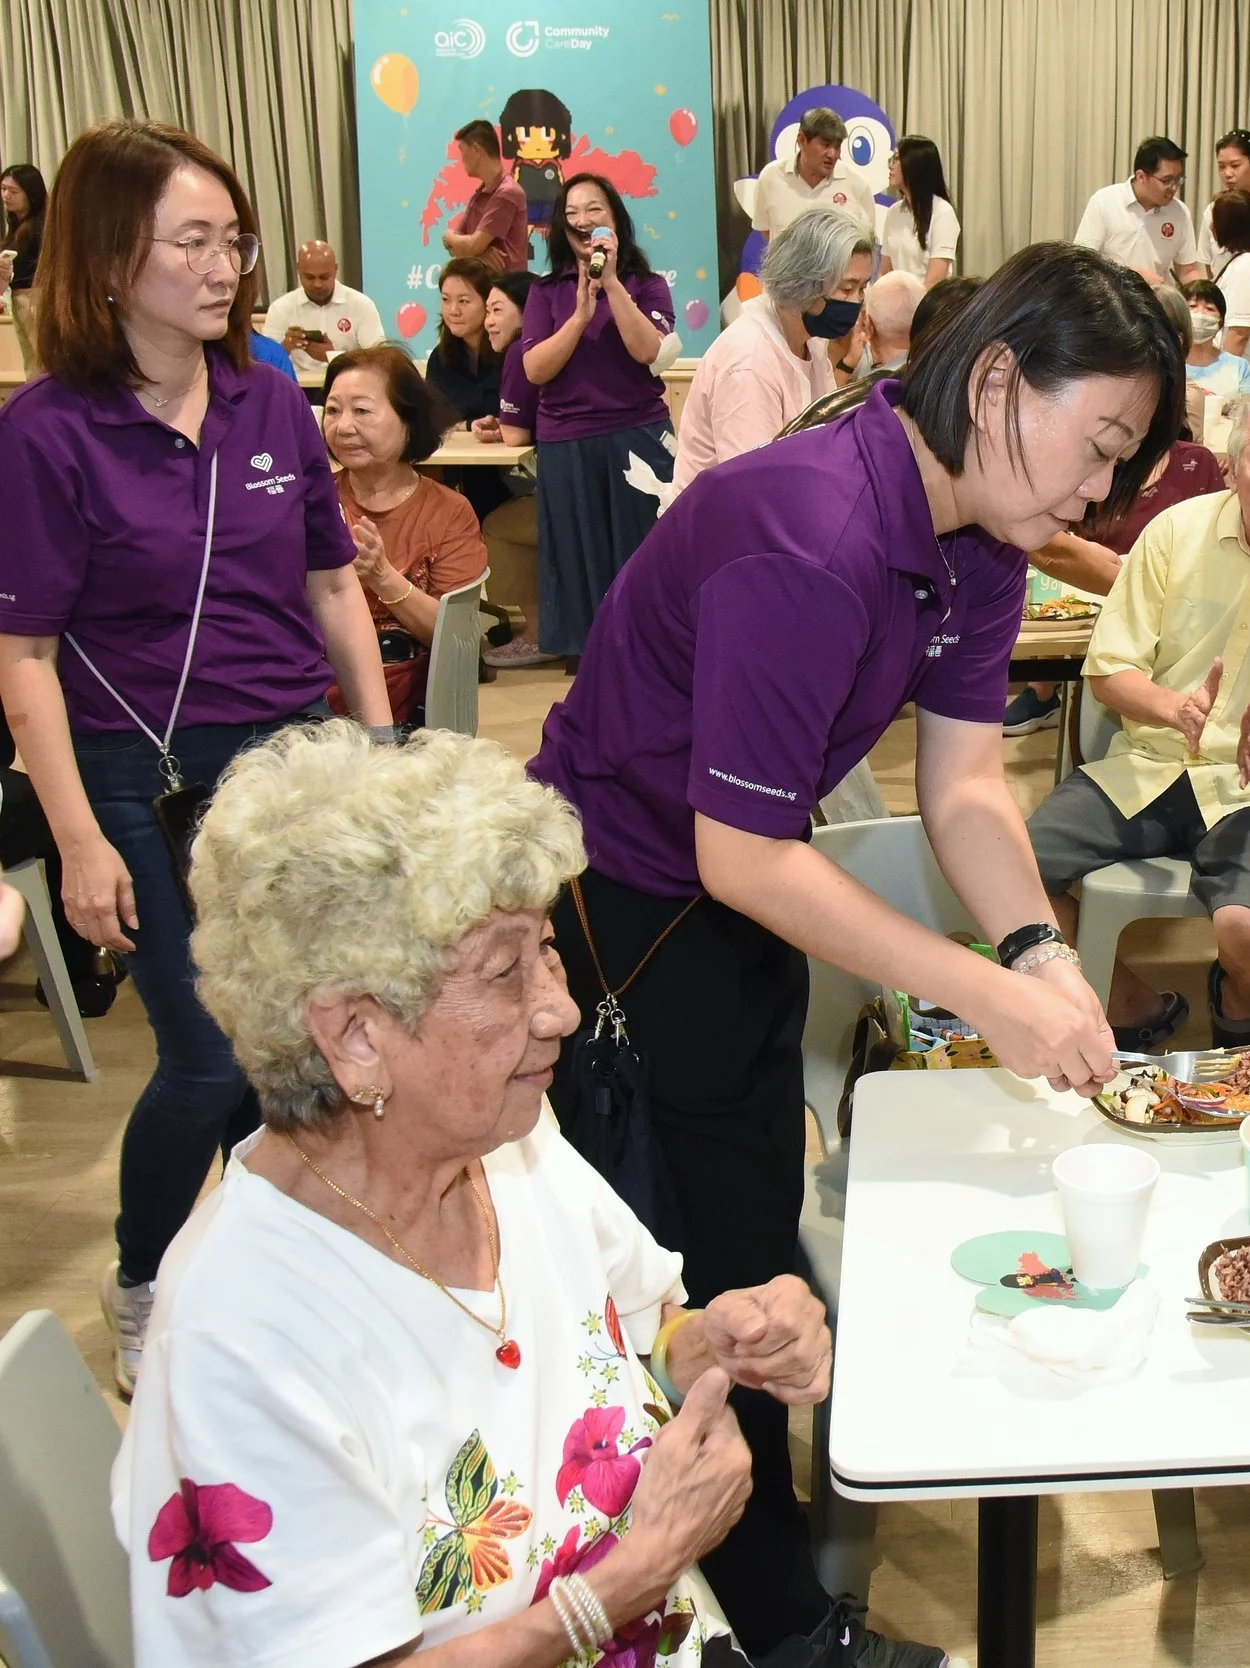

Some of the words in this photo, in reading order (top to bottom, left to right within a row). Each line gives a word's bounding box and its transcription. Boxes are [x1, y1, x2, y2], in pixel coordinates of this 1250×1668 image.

[545, 26, 610, 38] Community
[245, 478, 276, 491] Blossom
[275, 473, 296, 484] Seeds
[708, 766, 798, 801] www.blossomseeds.sg
